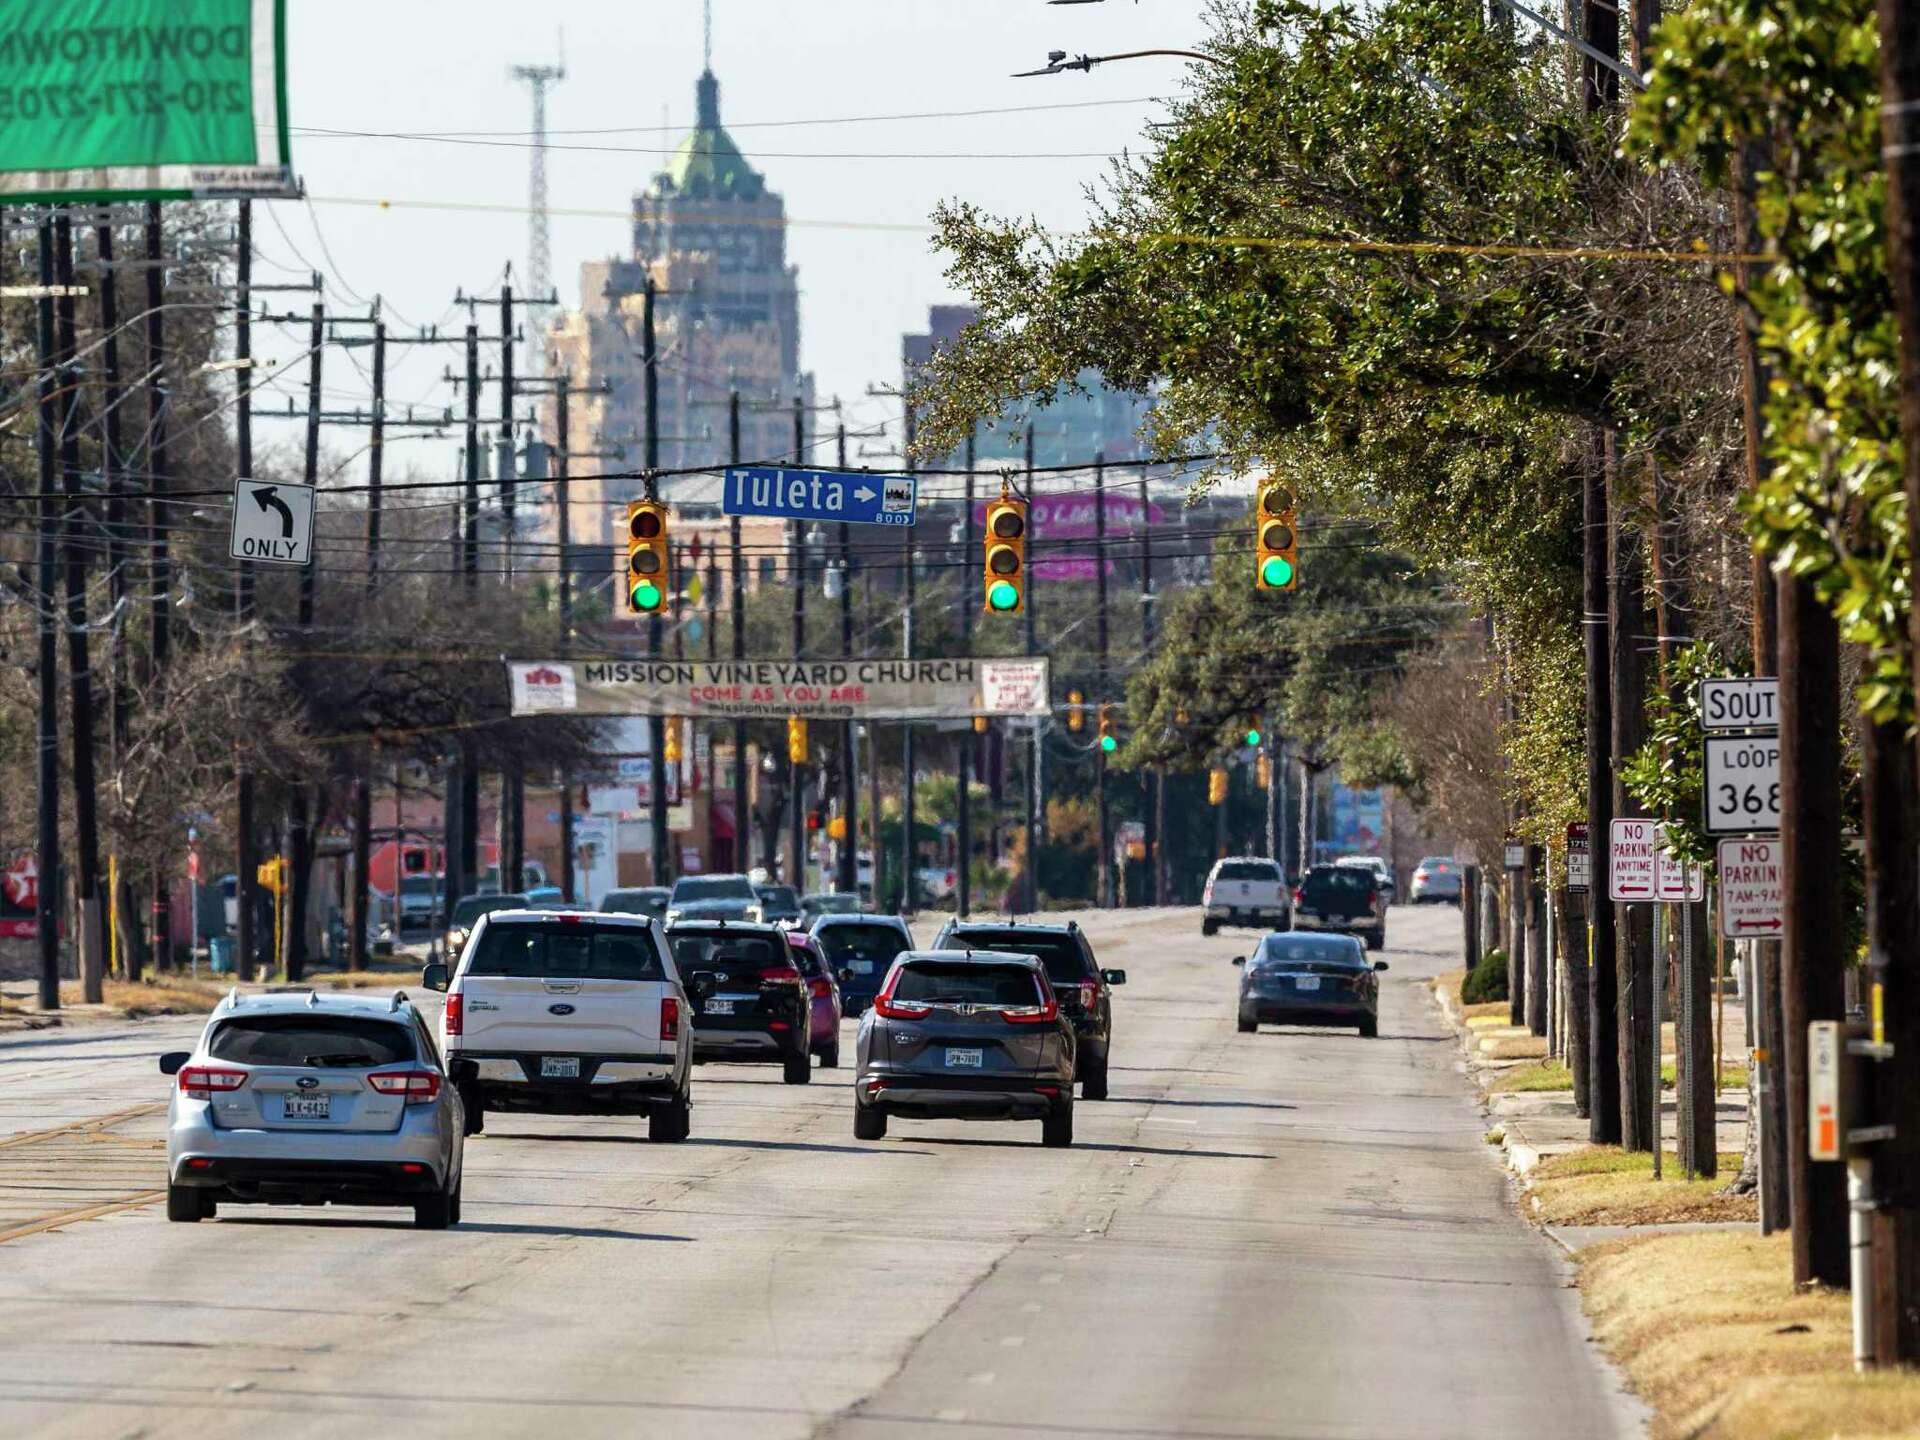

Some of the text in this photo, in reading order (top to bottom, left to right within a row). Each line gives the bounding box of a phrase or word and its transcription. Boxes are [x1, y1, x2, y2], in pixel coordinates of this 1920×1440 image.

[732, 470, 843, 511] Tuleta
[243, 537, 298, 559] ONLY
[585, 661, 973, 686] MISSION VINEYARD CHURCH
[689, 687, 742, 703] COME
[751, 687, 774, 701] AS
[783, 687, 820, 701] YOU
[1709, 688, 1775, 720] SOUT
[1723, 749, 1779, 769] LOOP
[1718, 783, 1780, 815] 368
[1624, 824, 1643, 840] NO
[1614, 843, 1653, 857] PARKING
[1741, 845, 1769, 862] NO
[1616, 861, 1651, 872] ANYTIME
[1725, 865, 1782, 884] PARKIN
